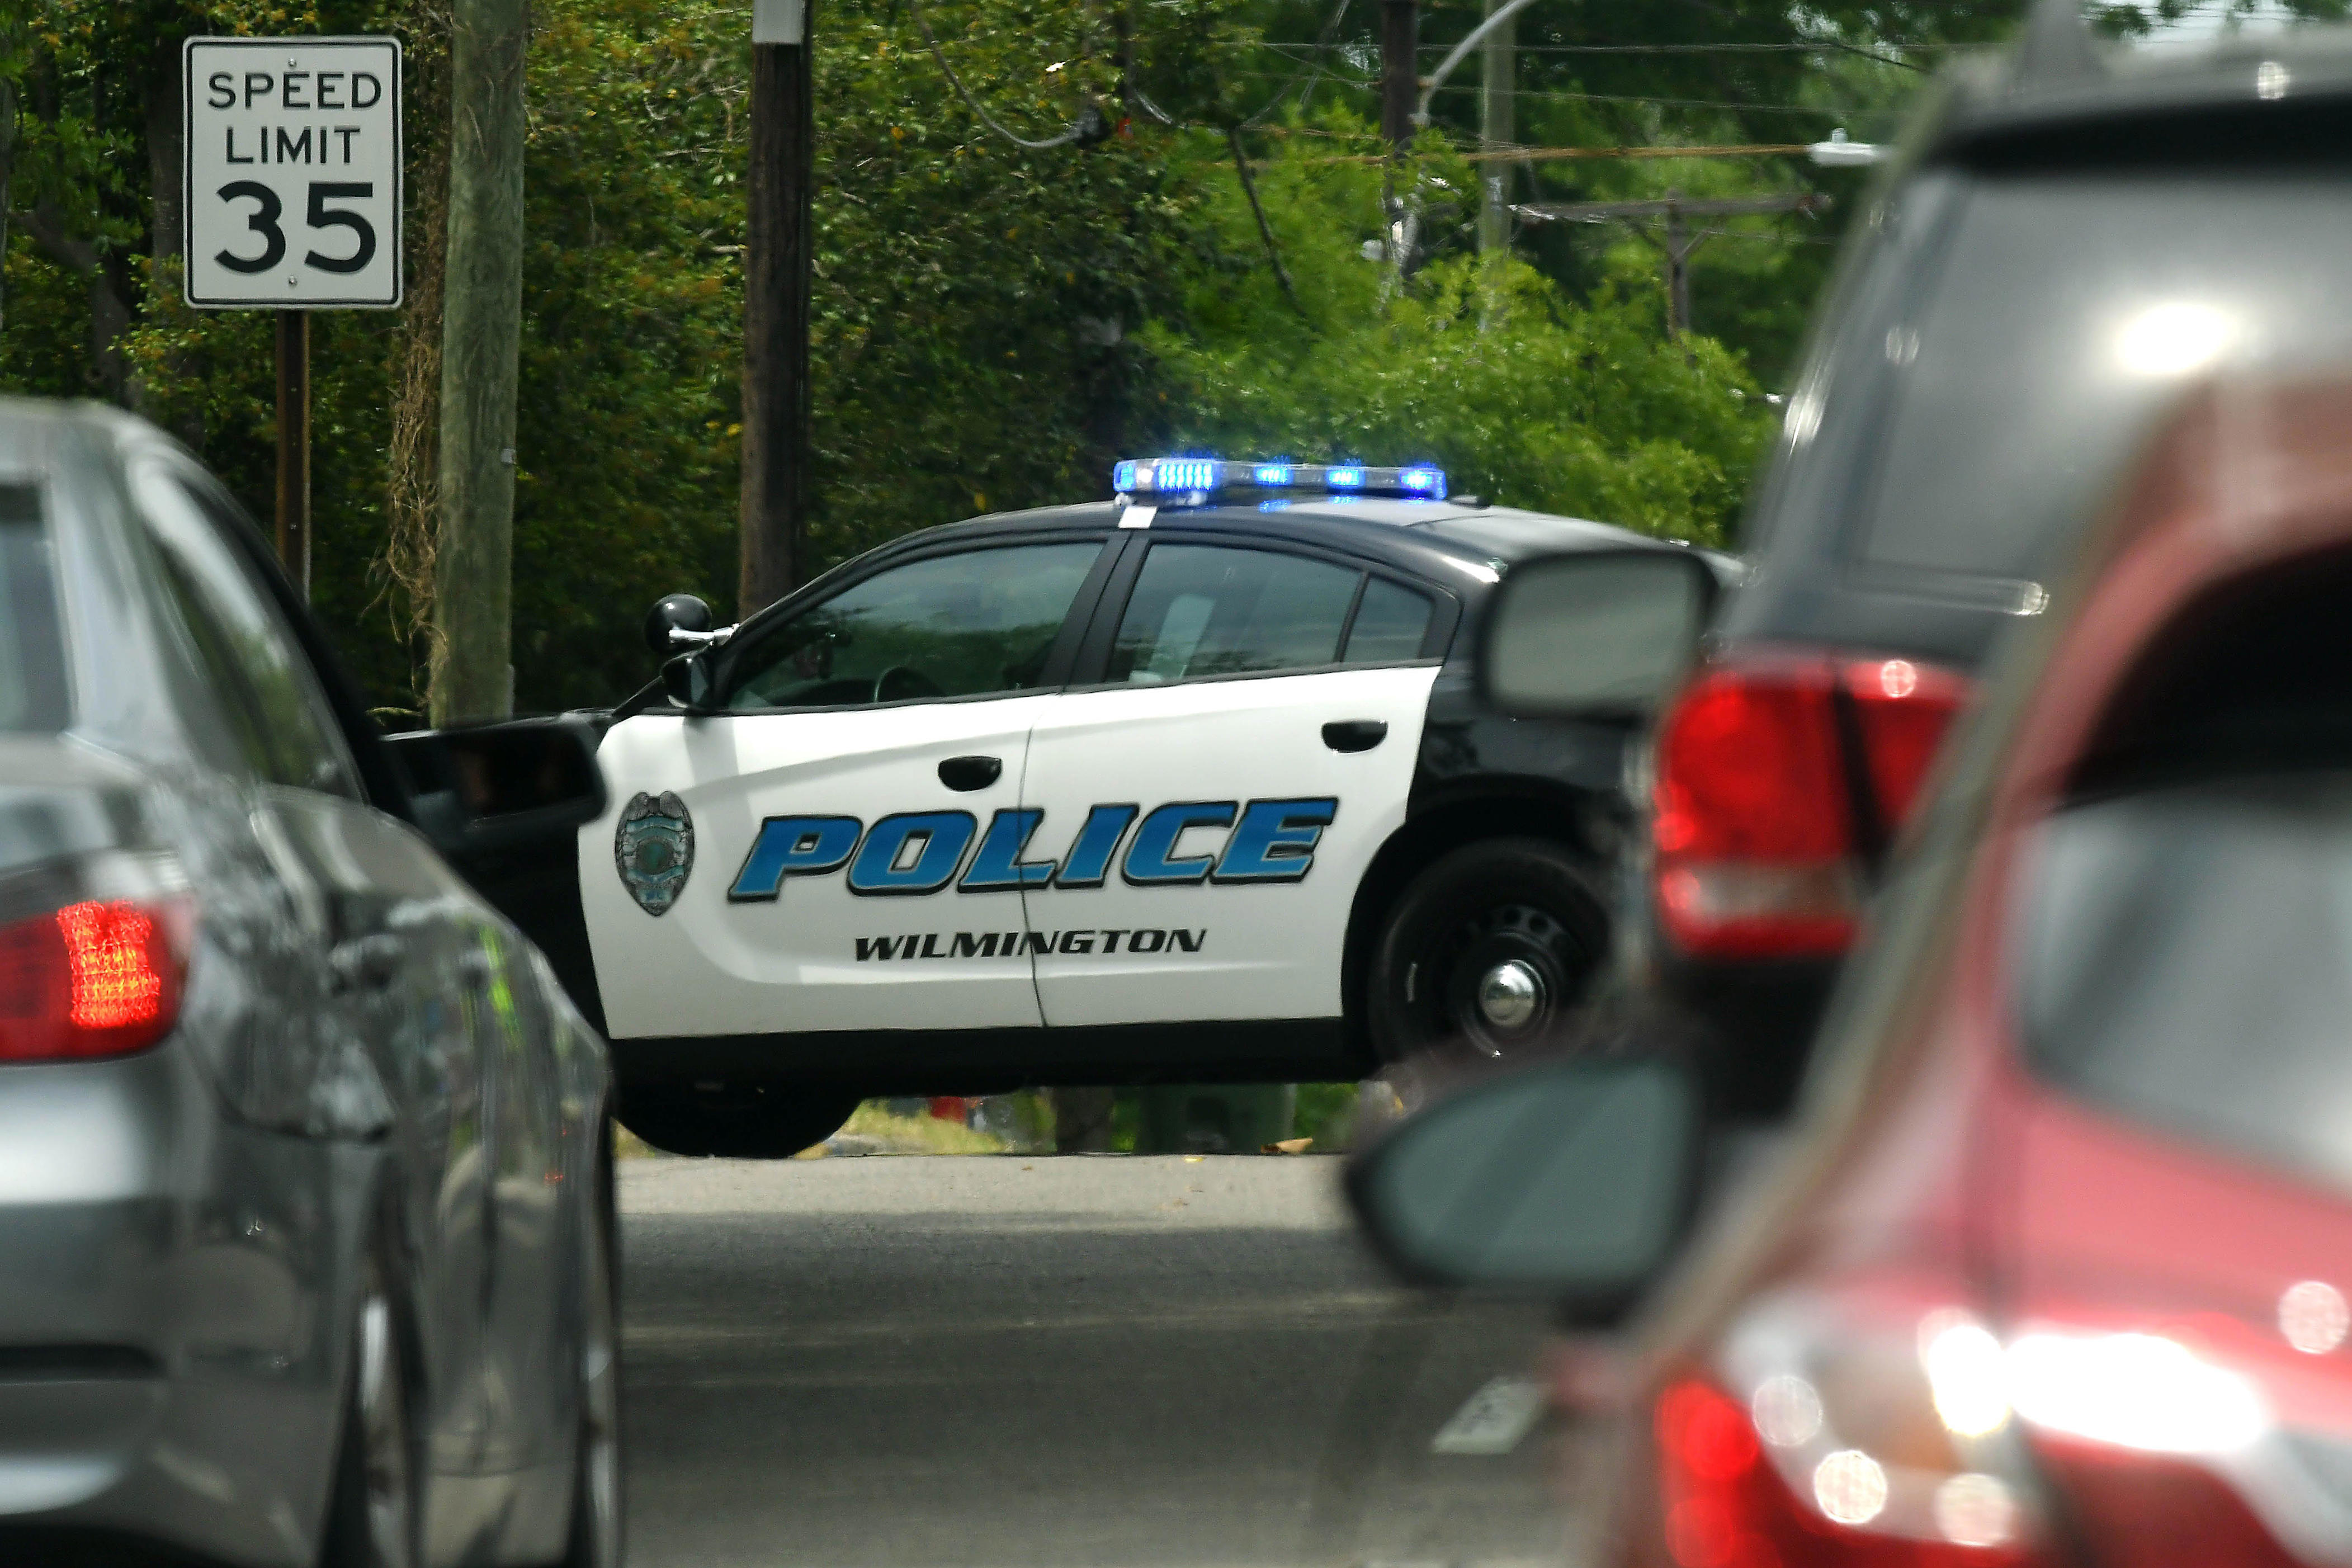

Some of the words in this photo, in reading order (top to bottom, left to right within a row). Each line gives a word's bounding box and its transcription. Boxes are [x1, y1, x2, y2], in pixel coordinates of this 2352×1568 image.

[208, 71, 382, 110] SPEED
[226, 125, 361, 165] LIMIT
[214, 180, 376, 275] 35
[726, 795, 1340, 903] POLICE
[854, 928, 1208, 962] WILMINGTON
